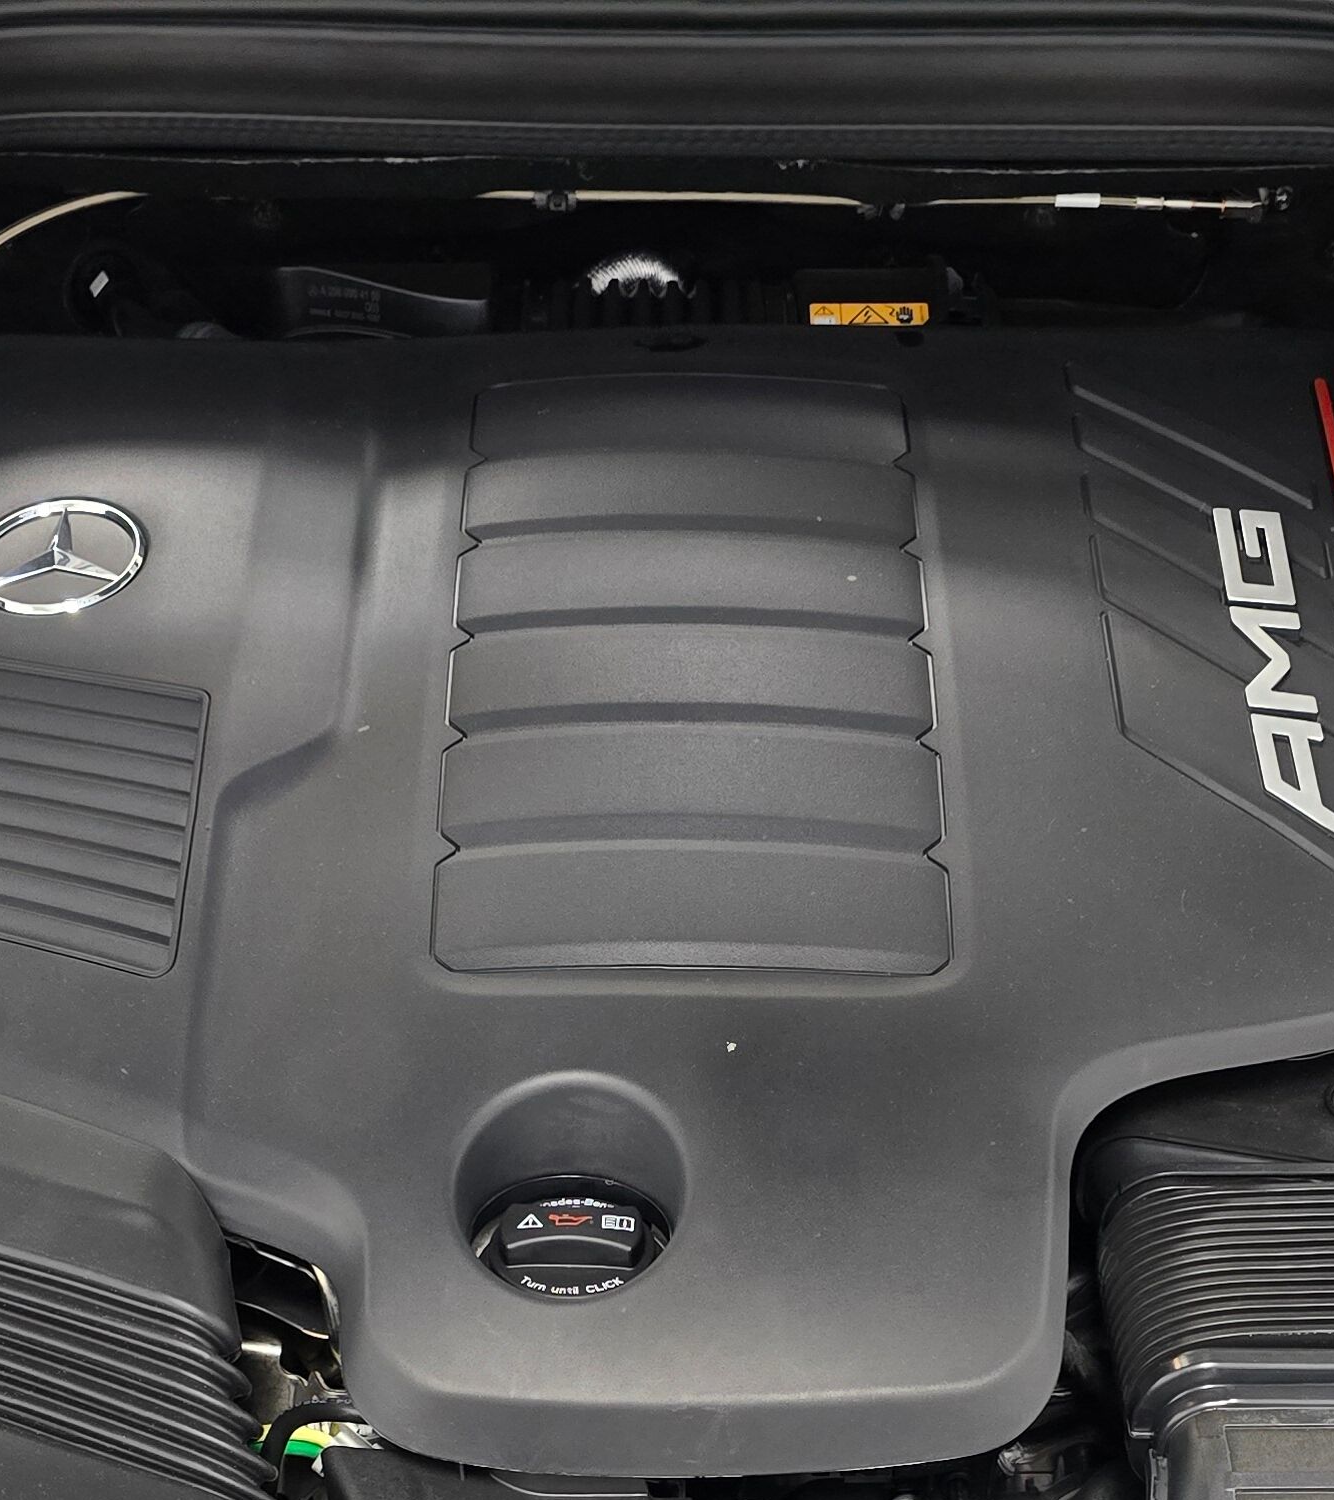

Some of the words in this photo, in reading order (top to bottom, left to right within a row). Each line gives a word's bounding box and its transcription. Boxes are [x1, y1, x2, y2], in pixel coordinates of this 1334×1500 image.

[520, 1275, 547, 1292] Turn
[550, 1284, 579, 1295] until
[585, 1276, 624, 1294] CLICK
